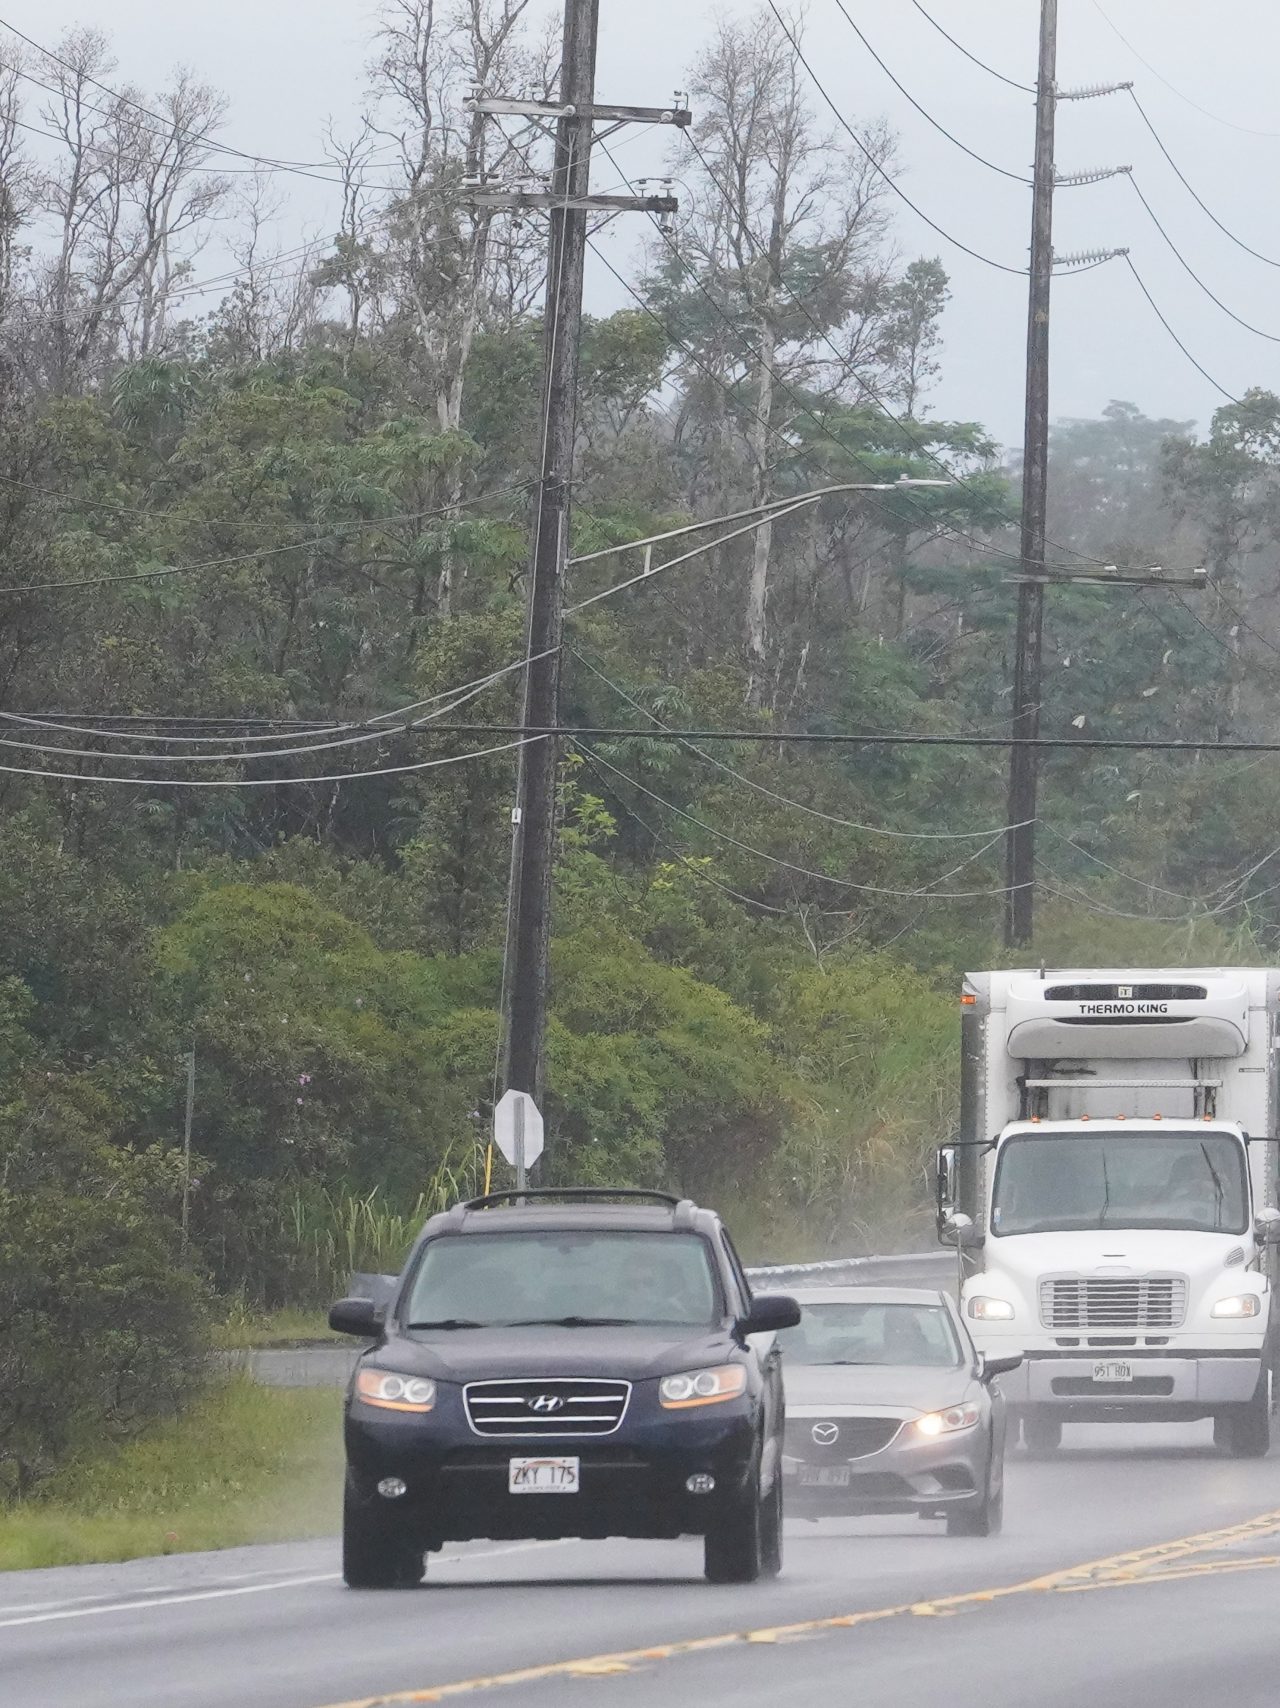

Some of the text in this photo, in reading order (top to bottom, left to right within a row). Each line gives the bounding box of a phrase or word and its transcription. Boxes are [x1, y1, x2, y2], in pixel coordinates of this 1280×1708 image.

[1079, 1003, 1168, 1014] THERMO KING
[513, 1466, 576, 1485] ZKY 175
